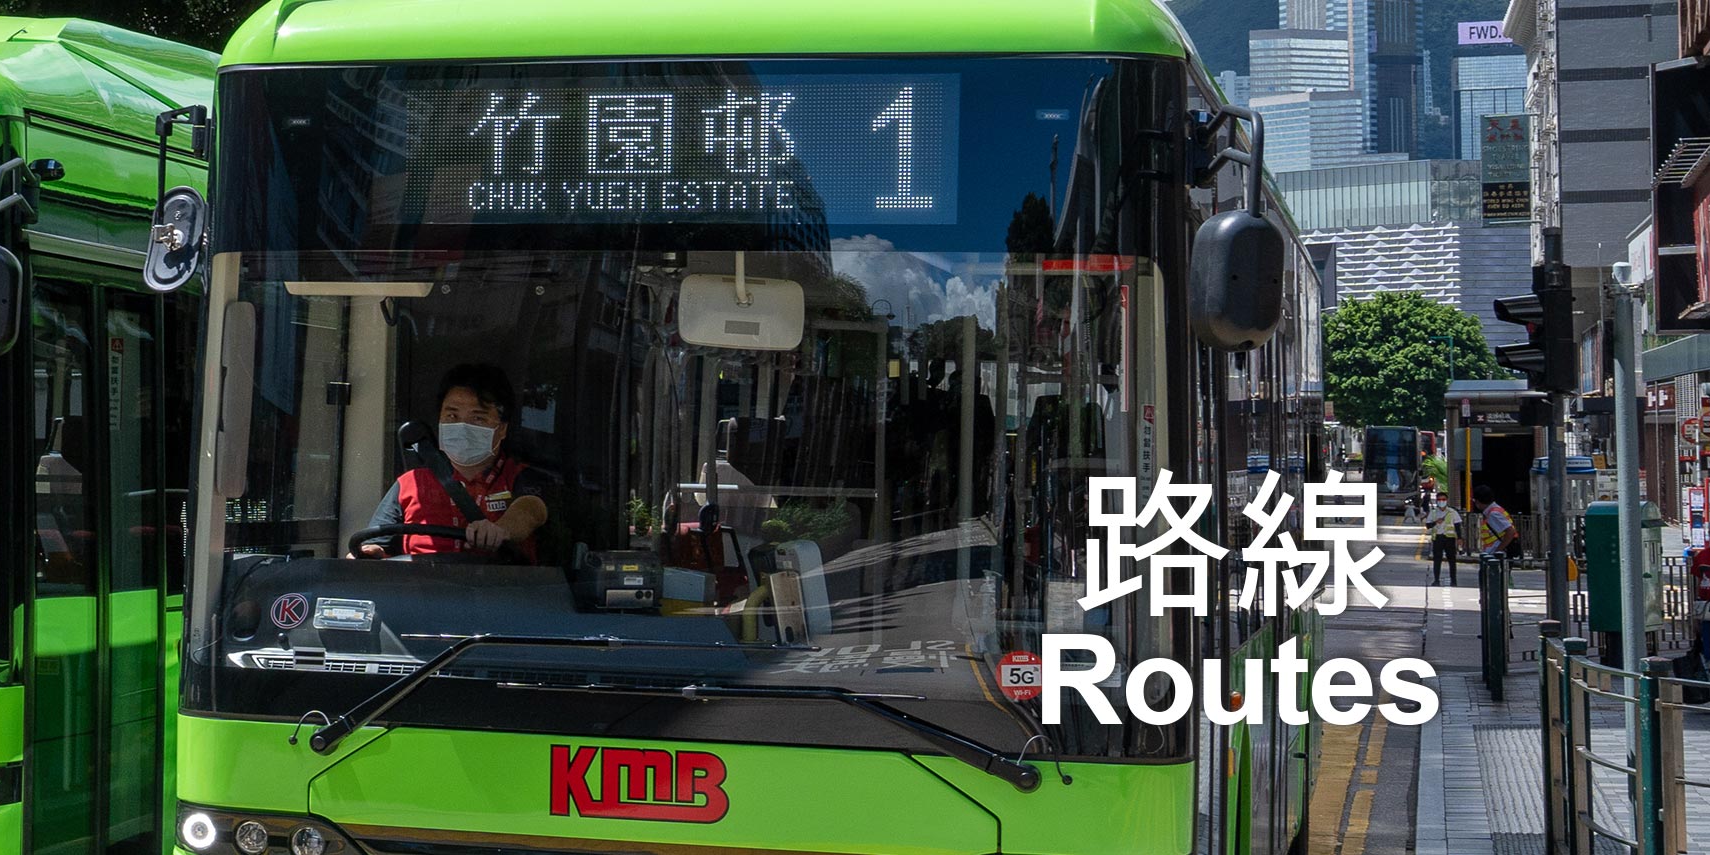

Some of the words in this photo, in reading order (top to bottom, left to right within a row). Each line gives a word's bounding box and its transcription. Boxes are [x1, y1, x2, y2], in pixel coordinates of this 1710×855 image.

[1469, 25, 1502, 40] FWD.
[469, 90, 795, 177] 竹園邨
[872, 86, 934, 210] 1
[468, 181, 547, 210] CHUK
[563, 181, 647, 210] YUEN
[662, 181, 795, 210] ESTATE
[278, 599, 302, 622] K
[1009, 667, 1035, 685] 5G
[550, 744, 730, 824] KMB
